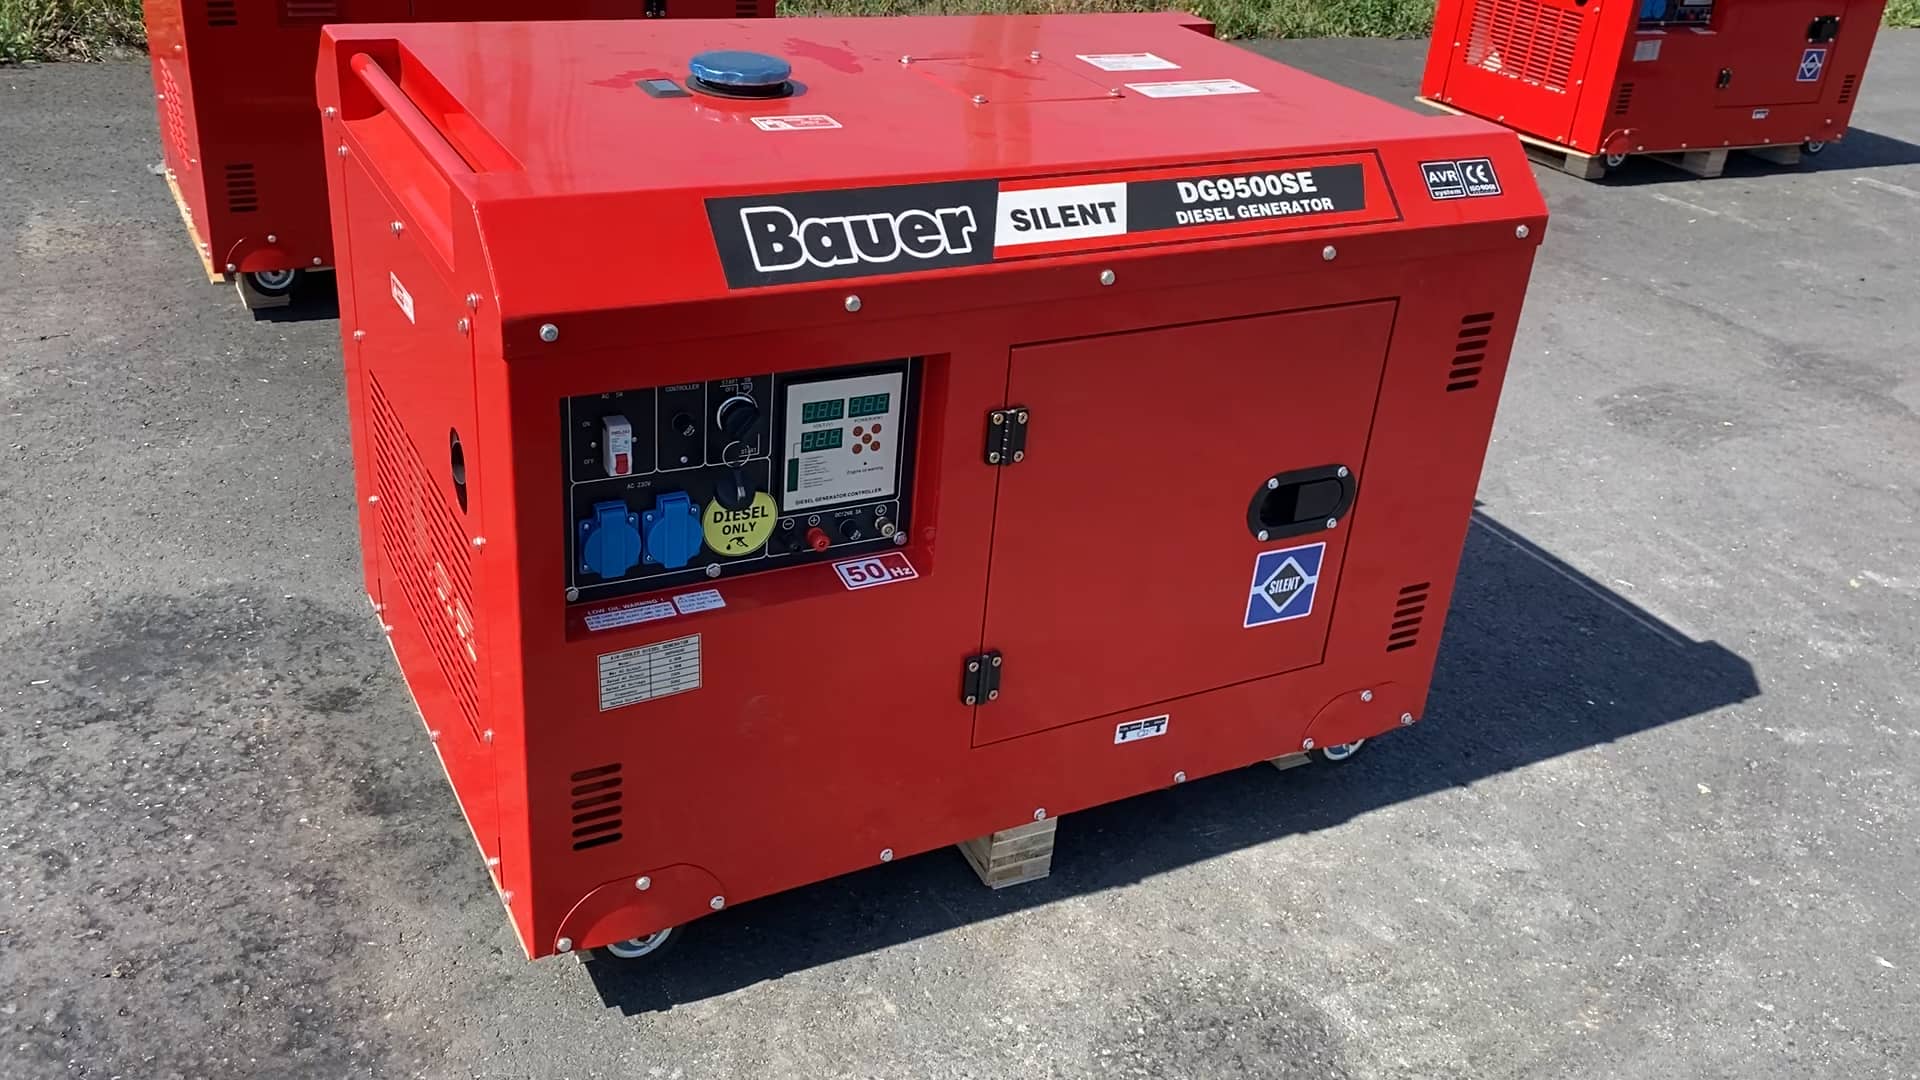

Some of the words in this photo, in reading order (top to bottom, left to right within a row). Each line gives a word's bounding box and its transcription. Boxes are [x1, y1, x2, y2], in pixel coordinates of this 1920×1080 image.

[1429, 170, 1458, 183] AVR
[1176, 171, 1318, 204] DG9500SE
[1434, 188, 1462, 197] system
[1010, 200, 1117, 232] SILENT
[1176, 207, 1235, 225] DIESEL
[1238, 197, 1335, 218] GENERATOR
[740, 206, 977, 272] Bauer
[815, 493, 846, 502] GENERATOR
[847, 487, 882, 497] CONTROLLER
[713, 505, 769, 524] DIESEL
[722, 522, 757, 535] ONLY
[849, 562, 885, 582] 50
[890, 566, 913, 578] Hz
[1268, 576, 1300, 594] SILENT
[588, 608, 605, 616] LOW
